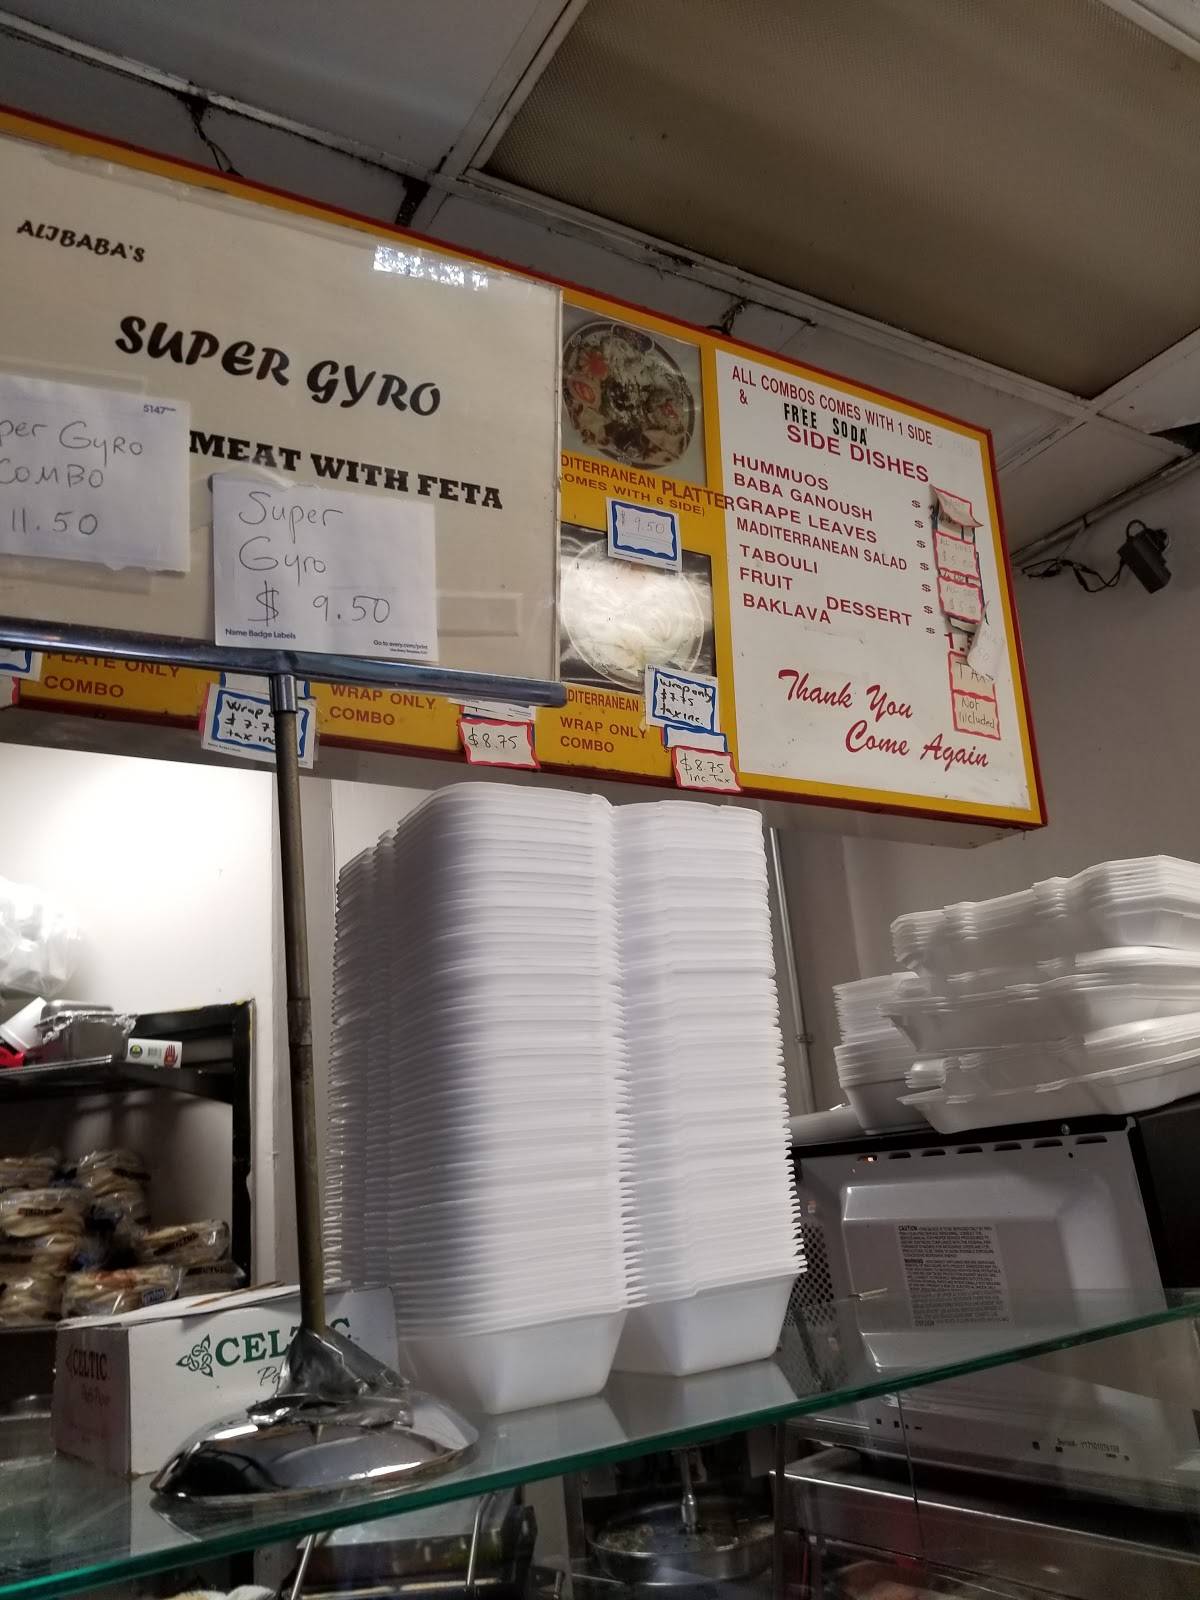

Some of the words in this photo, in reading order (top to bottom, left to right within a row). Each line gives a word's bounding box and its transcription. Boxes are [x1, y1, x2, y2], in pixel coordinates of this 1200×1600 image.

[16, 219, 146, 263] ALIBABA'S
[115, 316, 290, 386] SUPER
[306, 360, 441, 416] GYRO
[732, 365, 757, 387] ALL
[761, 375, 815, 406] COMBOS
[819, 394, 861, 421] COMES
[865, 408, 894, 433] WITH
[897, 422, 904, 436] 1
[907, 423, 933, 446] SIDE
[739, 388, 749, 405] &
[783, 402, 817, 430] FREE
[832, 417, 867, 446] SODA
[787, 424, 841, 456] SIDE
[850, 443, 929, 482] DISHES
[189, 430, 301, 471] MEAT
[310, 453, 409, 492] WITH
[417, 474, 504, 510] FETA
[561, 455, 656, 490] DITERRANEAN
[662, 479, 735, 511] PLATTER
[732, 453, 829, 491] HUMMUOS
[613, 485, 651, 503] WITH
[734, 472, 783, 498] BABA
[790, 488, 873, 522] GANOUSH
[12, 508, 98, 535] 11.50
[238, 491, 343, 544] Super
[736, 496, 801, 524] GRAPE
[808, 514, 877, 543] LEAVES
[736, 517, 859, 560] MADITERRANEAN
[864, 549, 907, 571] SALAD
[740, 544, 818, 574] TABOULI
[238, 536, 326, 586] Gyro
[739, 567, 793, 591] FRUIT
[743, 593, 831, 624] BAKLAVA
[826, 596, 912, 626] DESSERT
[225, 628, 248, 637] Name
[249, 629, 272, 639] Badge
[274, 631, 296, 640] Labels
[124, 659, 180, 678] ONLY
[44, 675, 124, 698] COMBO
[330, 684, 383, 702] WRAP
[390, 692, 436, 709] ONLY
[567, 689, 639, 713] DITERRANEAN
[778, 669, 853, 708] Thank
[866, 684, 912, 722] You
[329, 706, 396, 726] COMBO
[560, 716, 603, 732] WRAP
[609, 724, 647, 739] ONLY
[468, 727, 518, 750] $8.75
[560, 736, 614, 753] COMBO
[845, 719, 910, 756] Come
[919, 733, 989, 772] Again
[72, 1349, 107, 1381] CELTIC
